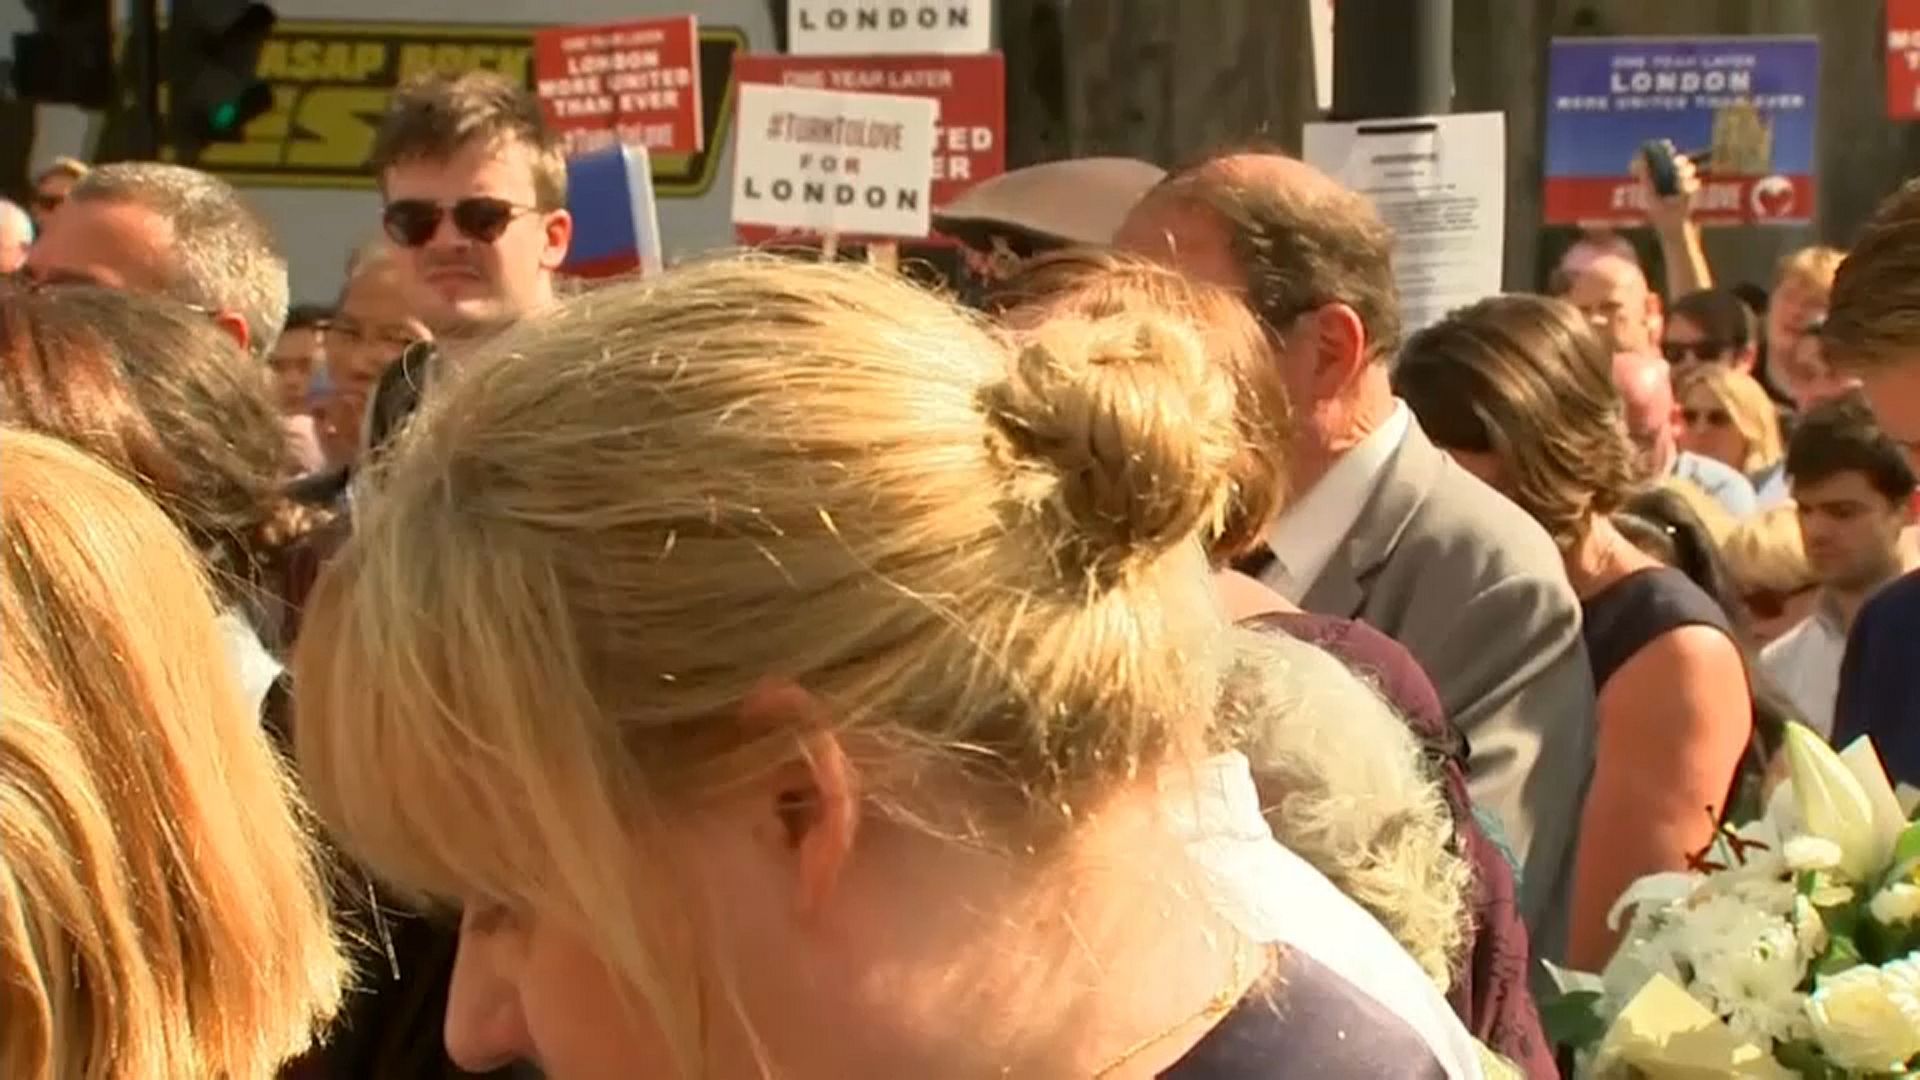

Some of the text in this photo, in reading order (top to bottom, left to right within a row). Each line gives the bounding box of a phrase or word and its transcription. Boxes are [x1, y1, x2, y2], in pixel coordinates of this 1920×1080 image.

[800, 8, 969, 30] LONDON
[568, 51, 658, 74] LONDON
[538, 68, 689, 97] MORE UNITED
[783, 70, 952, 88] ONE YEAR LATER
[1610, 71, 1750, 93] LONDON
[554, 91, 679, 117] THAN EVER
[1556, 96, 1609, 111] MORE
[1617, 95, 1687, 111] UNITED
[932, 127, 992, 149] TED
[800, 155, 860, 172] FOR
[931, 156, 970, 180] ER
[745, 179, 918, 209] LONDON
